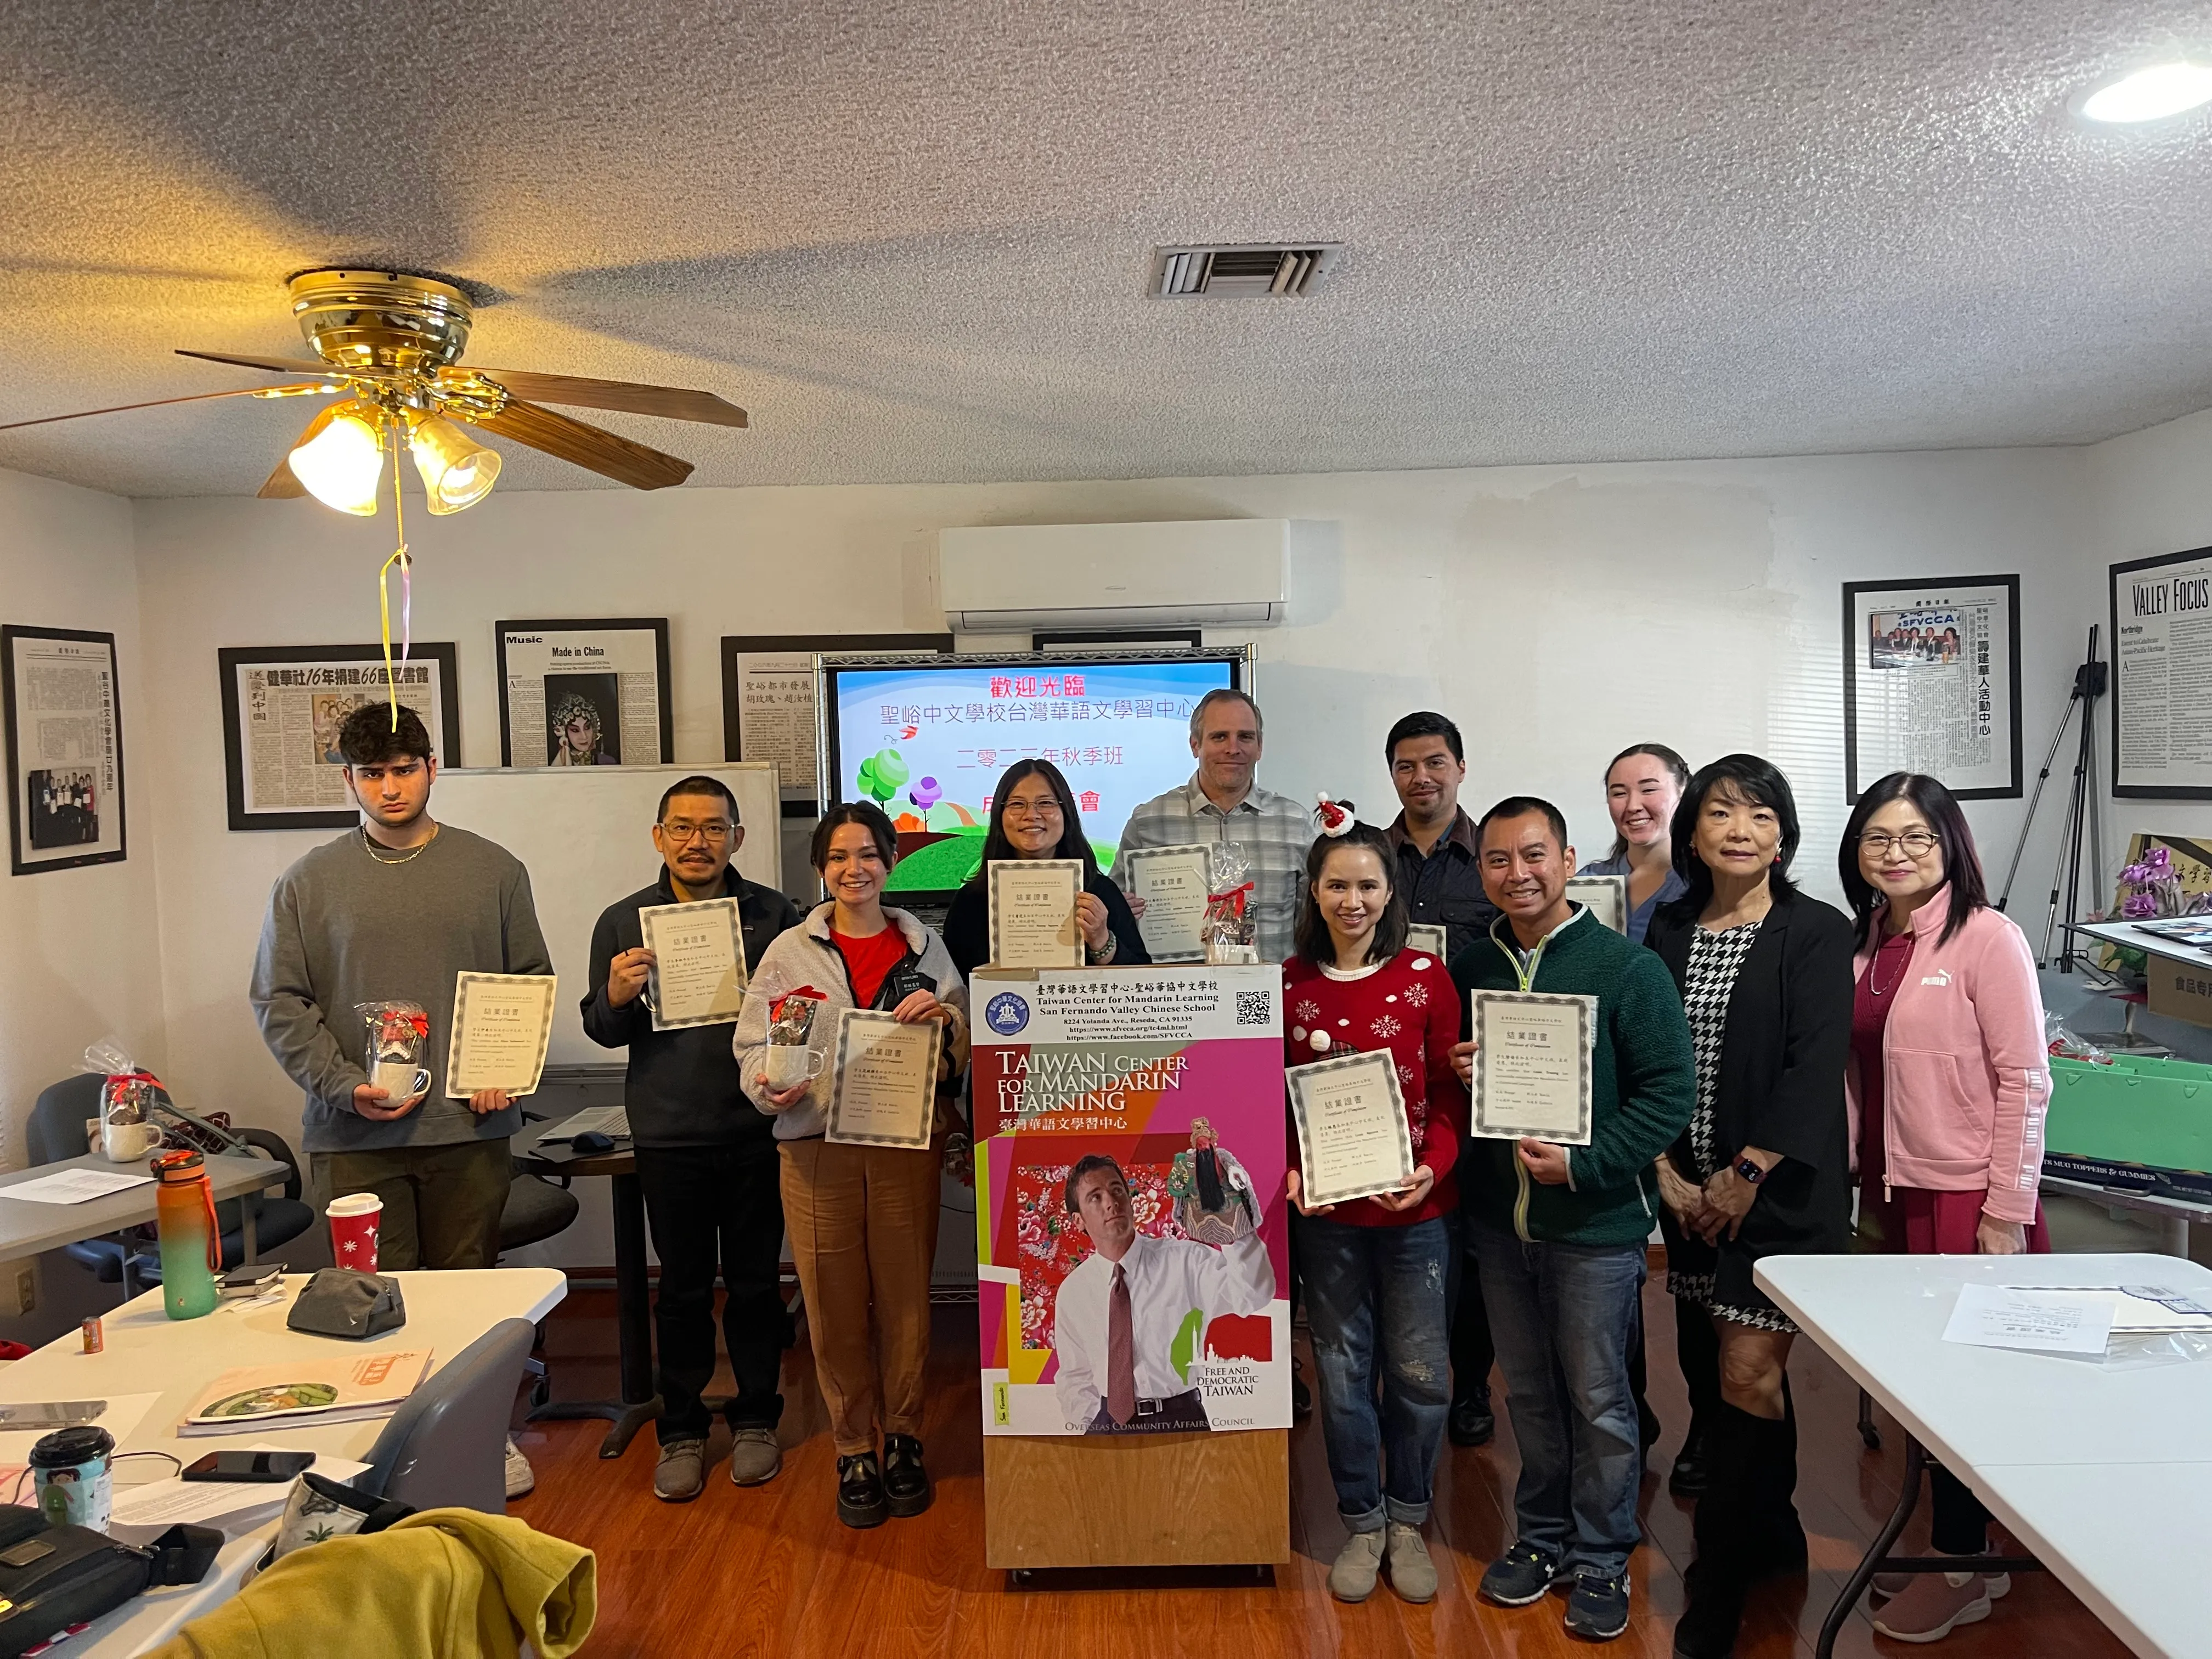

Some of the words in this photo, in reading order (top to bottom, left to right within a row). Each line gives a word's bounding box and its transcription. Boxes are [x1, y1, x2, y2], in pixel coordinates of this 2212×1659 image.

[2133, 584, 2168, 617] VALLEY
[2174, 579, 2209, 612] FOCUS
[1902, 614, 1954, 627] SFVCCA
[552, 647, 572, 657] Made
[574, 647, 582, 656] in
[584, 646, 604, 656] China
[990, 675, 1086, 698] 歡迎光臨
[880, 698, 1194, 725] 聖峪中文學校台灣華語文學習中心
[1125, 995, 1172, 1003] Mandarin
[1176, 994, 1219, 1002] Learning
[1062, 1006, 1108, 1014] Fernando
[1110, 1005, 1140, 1015] Valley
[1143, 1005, 1181, 1013] Chinese
[1183, 1004, 1215, 1012] School
[995, 1051, 1107, 1075] TAIWAN
[1114, 1056, 1189, 1071] CENTER
[997, 1080, 1039, 1093] FOR
[1040, 1071, 1181, 1093] MANDARIN
[998, 1092, 1126, 1113] LEARNING
[999, 1116, 1127, 1131] 臺灣華語文學習中心
[2053, 1160, 2071, 1169] MUG
[2072, 1163, 2107, 1174] TOPPERS
[2109, 1168, 2117, 1176] &
[2118, 1170, 2156, 1181] GUMMIES
[1205, 1367, 1226, 1376] FREE
[1228, 1366, 1250, 1375] AND
[1197, 1375, 1259, 1386] DEMOCRATIC
[1203, 1385, 1254, 1397] TAIWAN
[1065, 1421, 1110, 1431] OVERSEAS
[1112, 1421, 1171, 1431] COMMUNITY
[1173, 1419, 1209, 1430] AFFAIRS
[1212, 1417, 1255, 1427] COUNCIL
